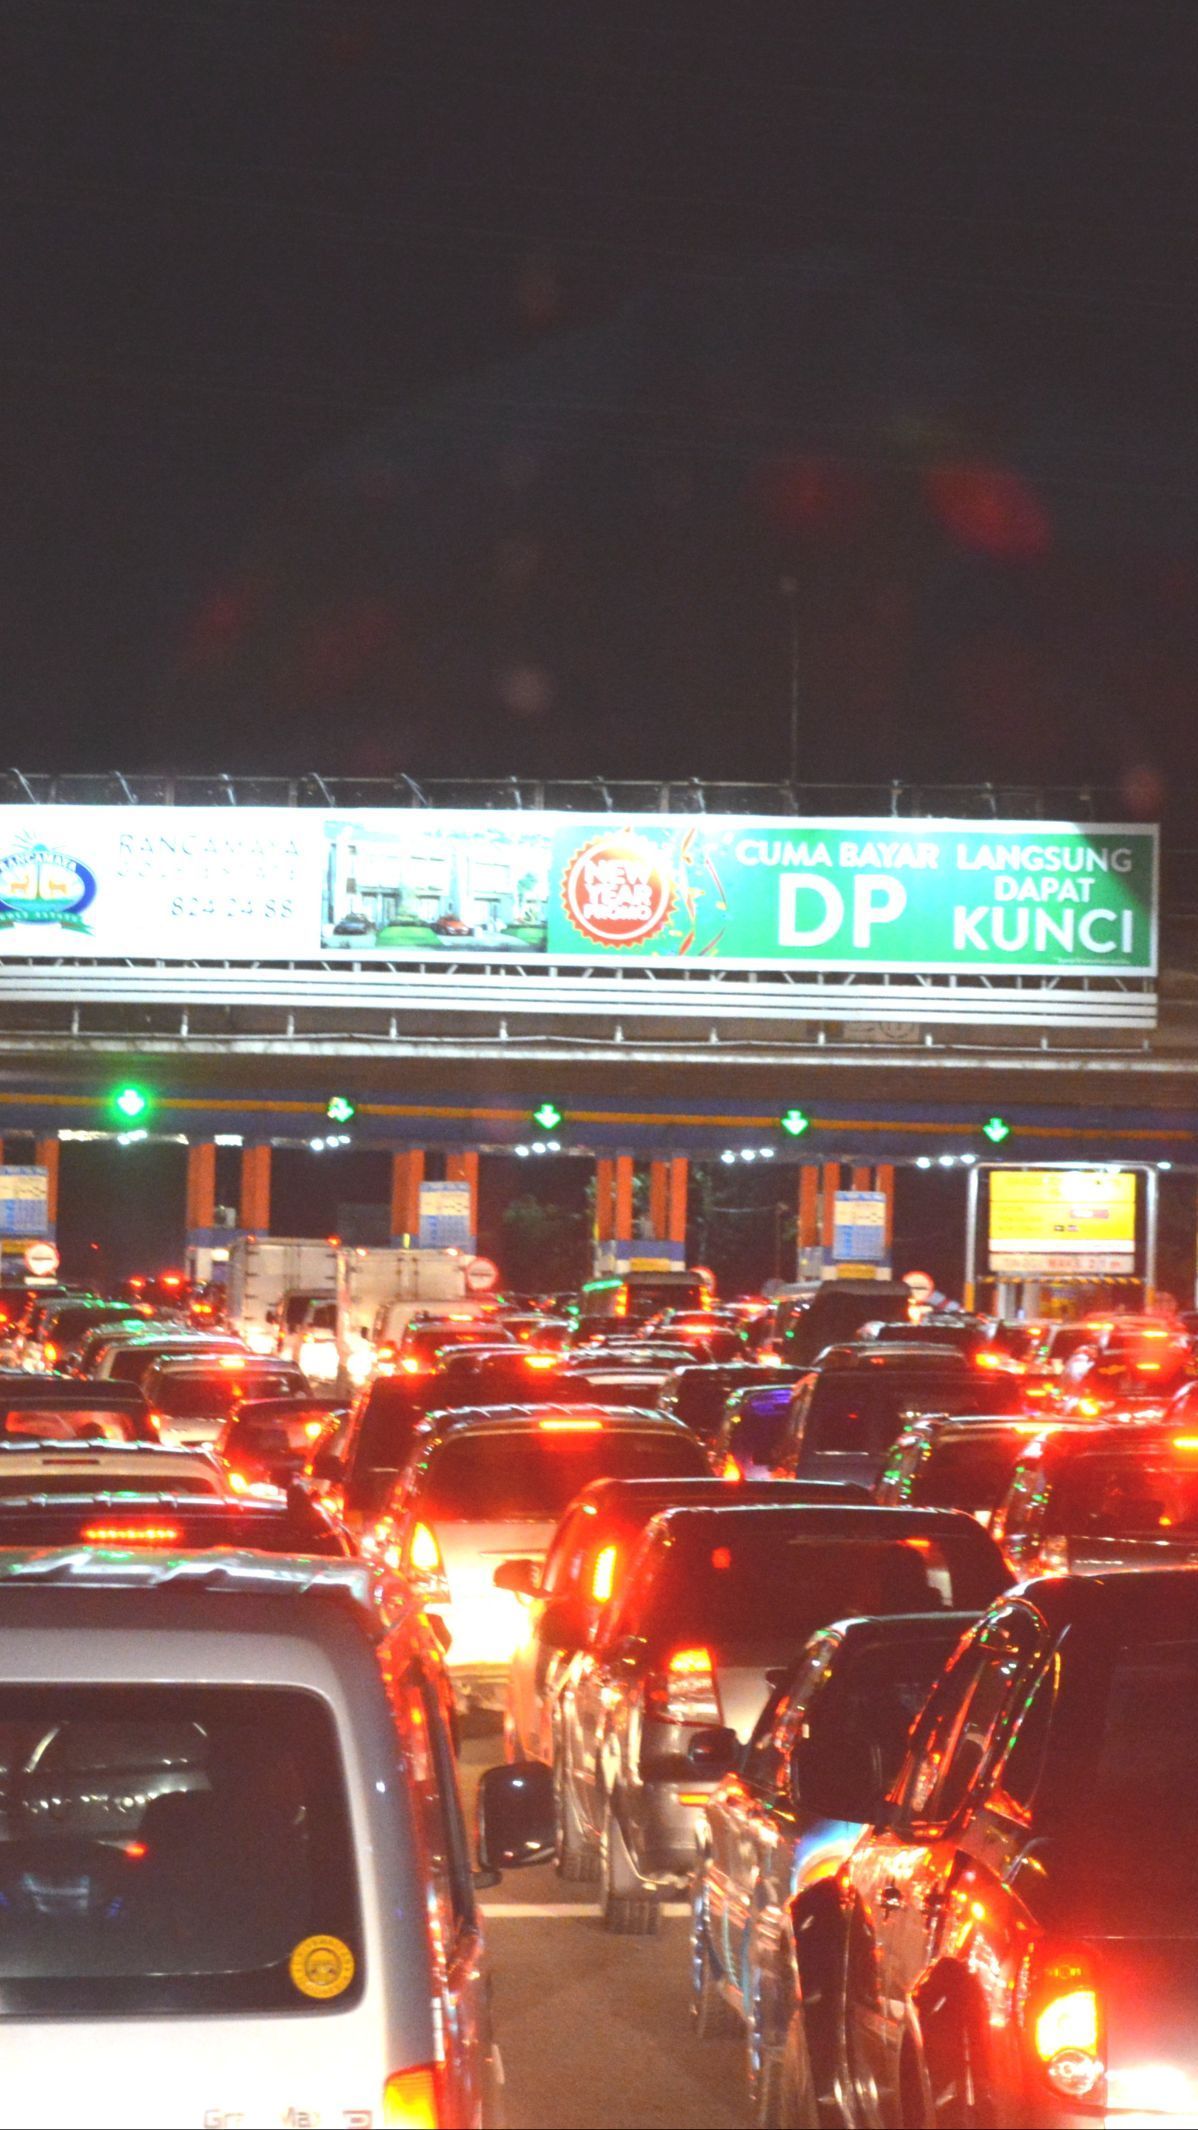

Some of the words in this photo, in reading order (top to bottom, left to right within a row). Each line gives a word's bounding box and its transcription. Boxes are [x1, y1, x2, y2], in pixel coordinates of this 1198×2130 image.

[119, 833, 299, 855] RANCAMAYA
[735, 840, 832, 867] CUMA
[839, 842, 939, 869] BAYAR
[957, 844, 1132, 872] LANGSUNG
[583, 859, 651, 886] NEW
[586, 884, 652, 906] YEAR
[994, 876, 1095, 902] DAPAT
[778, 873, 907, 948] DP
[954, 906, 1133, 953] KUNCI
